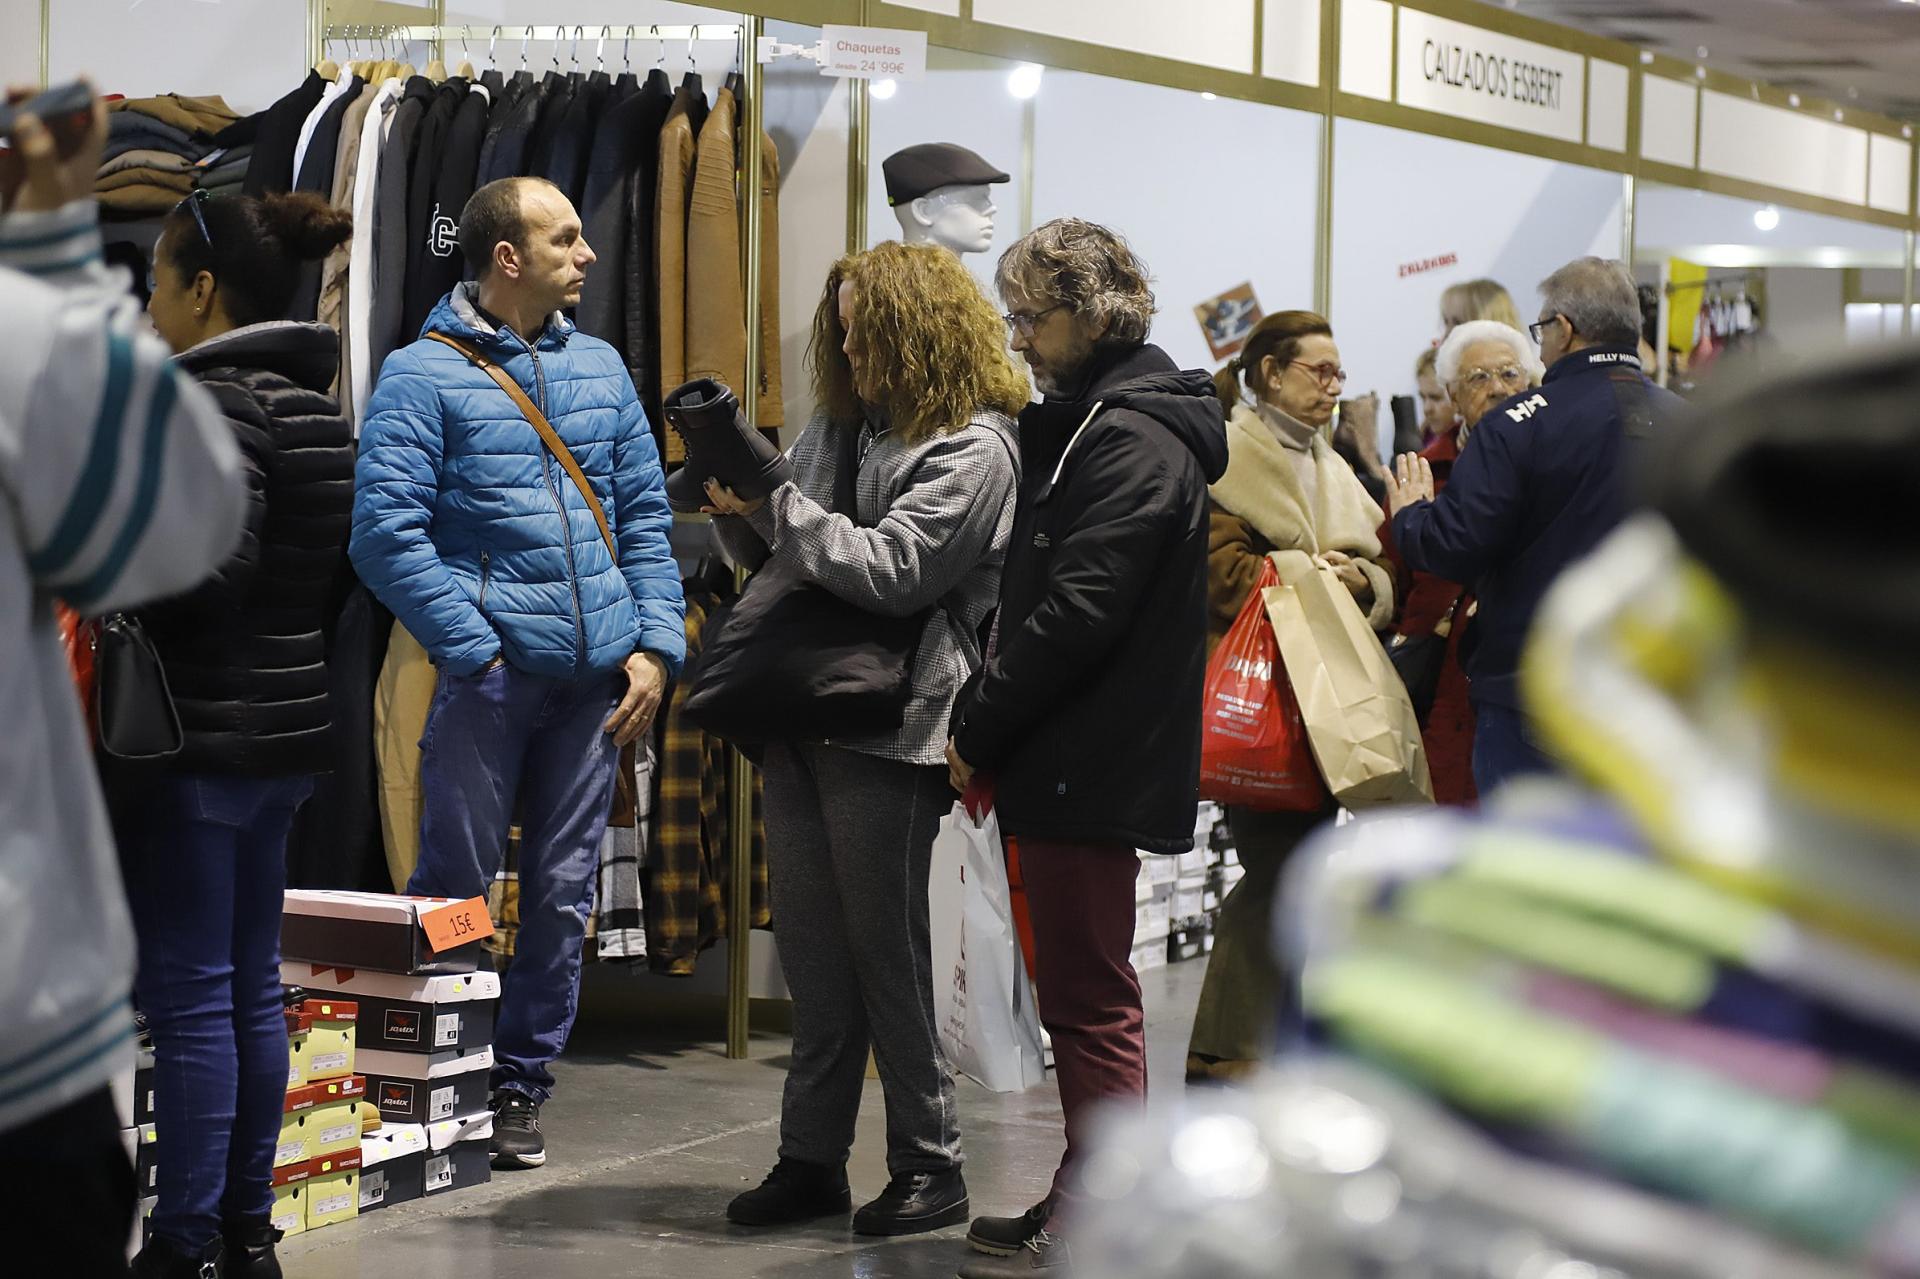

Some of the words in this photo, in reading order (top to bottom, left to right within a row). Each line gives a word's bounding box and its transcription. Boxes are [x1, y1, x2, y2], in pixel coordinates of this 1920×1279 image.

[836, 39, 901, 55] Chaquetas
[1423, 39, 1508, 97] CALZADOS
[1513, 61, 1562, 111] ESBERT
[1589, 353, 1618, 363] HELLY
[1505, 393, 1548, 422] HH
[449, 912, 475, 937] 15€
